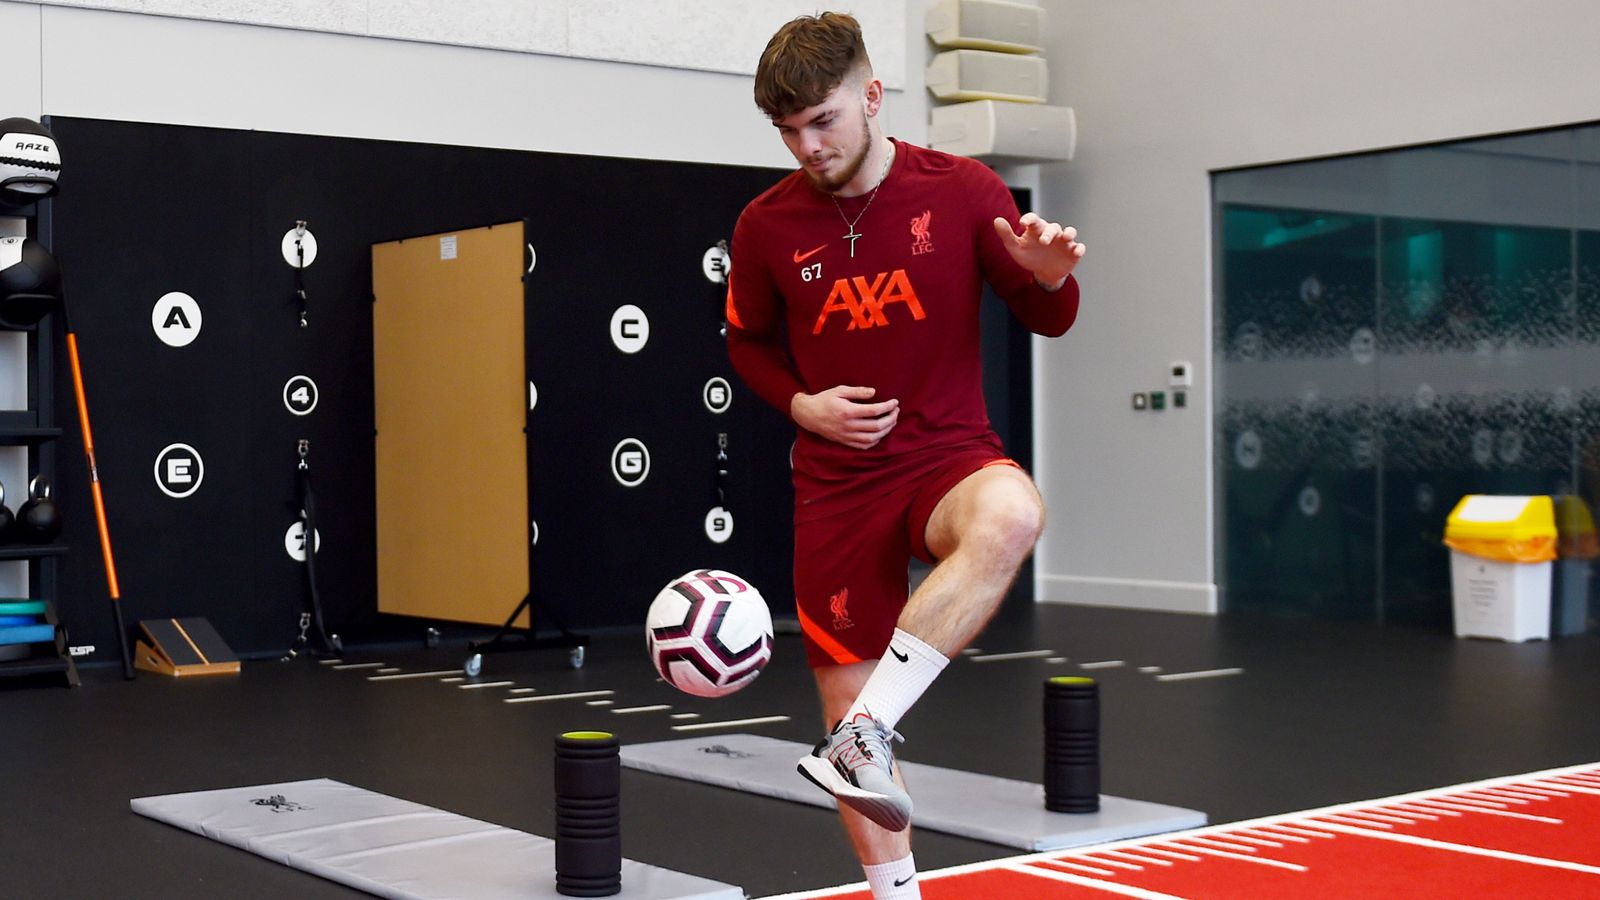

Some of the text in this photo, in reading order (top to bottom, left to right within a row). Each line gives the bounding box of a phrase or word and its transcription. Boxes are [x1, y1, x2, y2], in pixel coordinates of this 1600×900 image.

[15, 142, 50, 152] RAZE
[711, 257, 725, 272] 3
[801, 262, 822, 282] 67
[813, 269, 926, 335] AXA
[162, 306, 192, 329] A
[620, 319, 639, 339] C
[291, 386, 310, 404] 4
[710, 387, 725, 403] 6
[167, 458, 192, 483] E
[620, 451, 642, 474] G
[713, 517, 726, 532] 9
